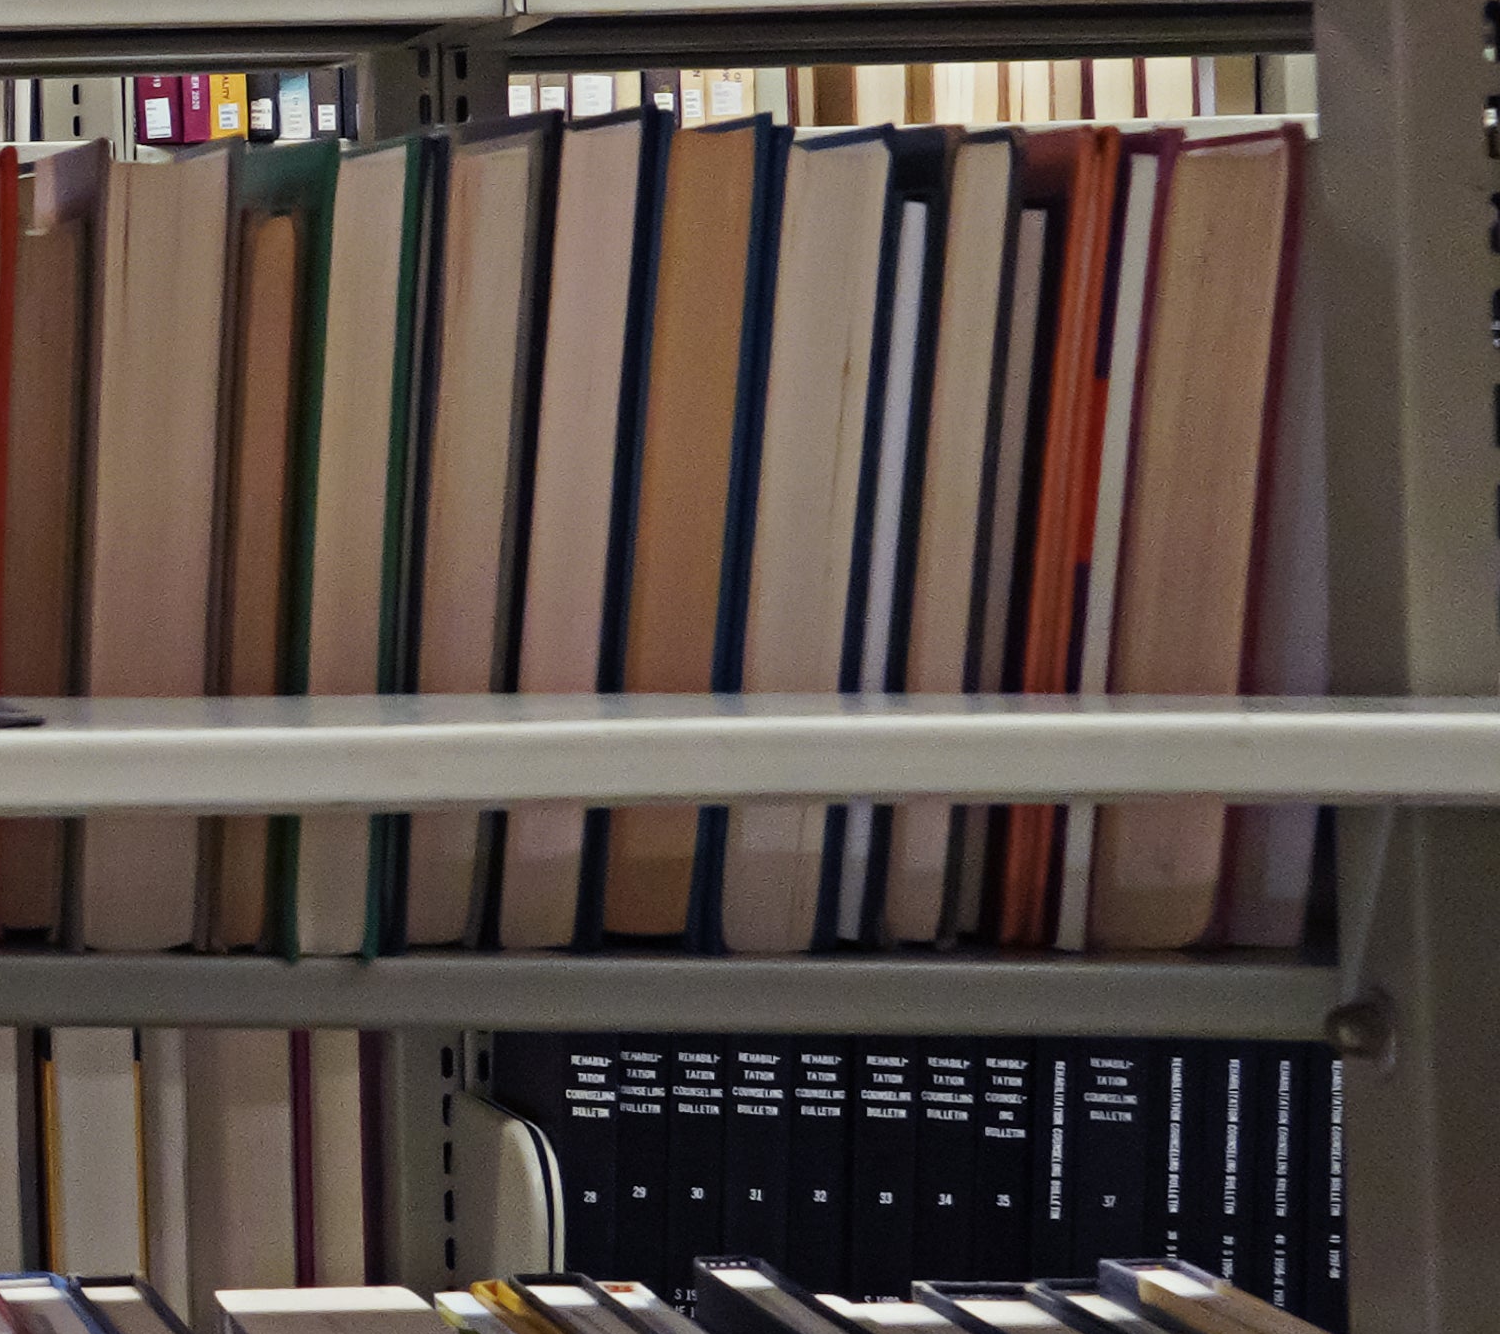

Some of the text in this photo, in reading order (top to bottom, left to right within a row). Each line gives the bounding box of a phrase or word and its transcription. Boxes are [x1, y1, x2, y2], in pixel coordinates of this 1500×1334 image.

[737, 1104, 779, 1116] BULLETIN
[690, 1187, 704, 1200] 30
[749, 1189, 763, 1201] 31
